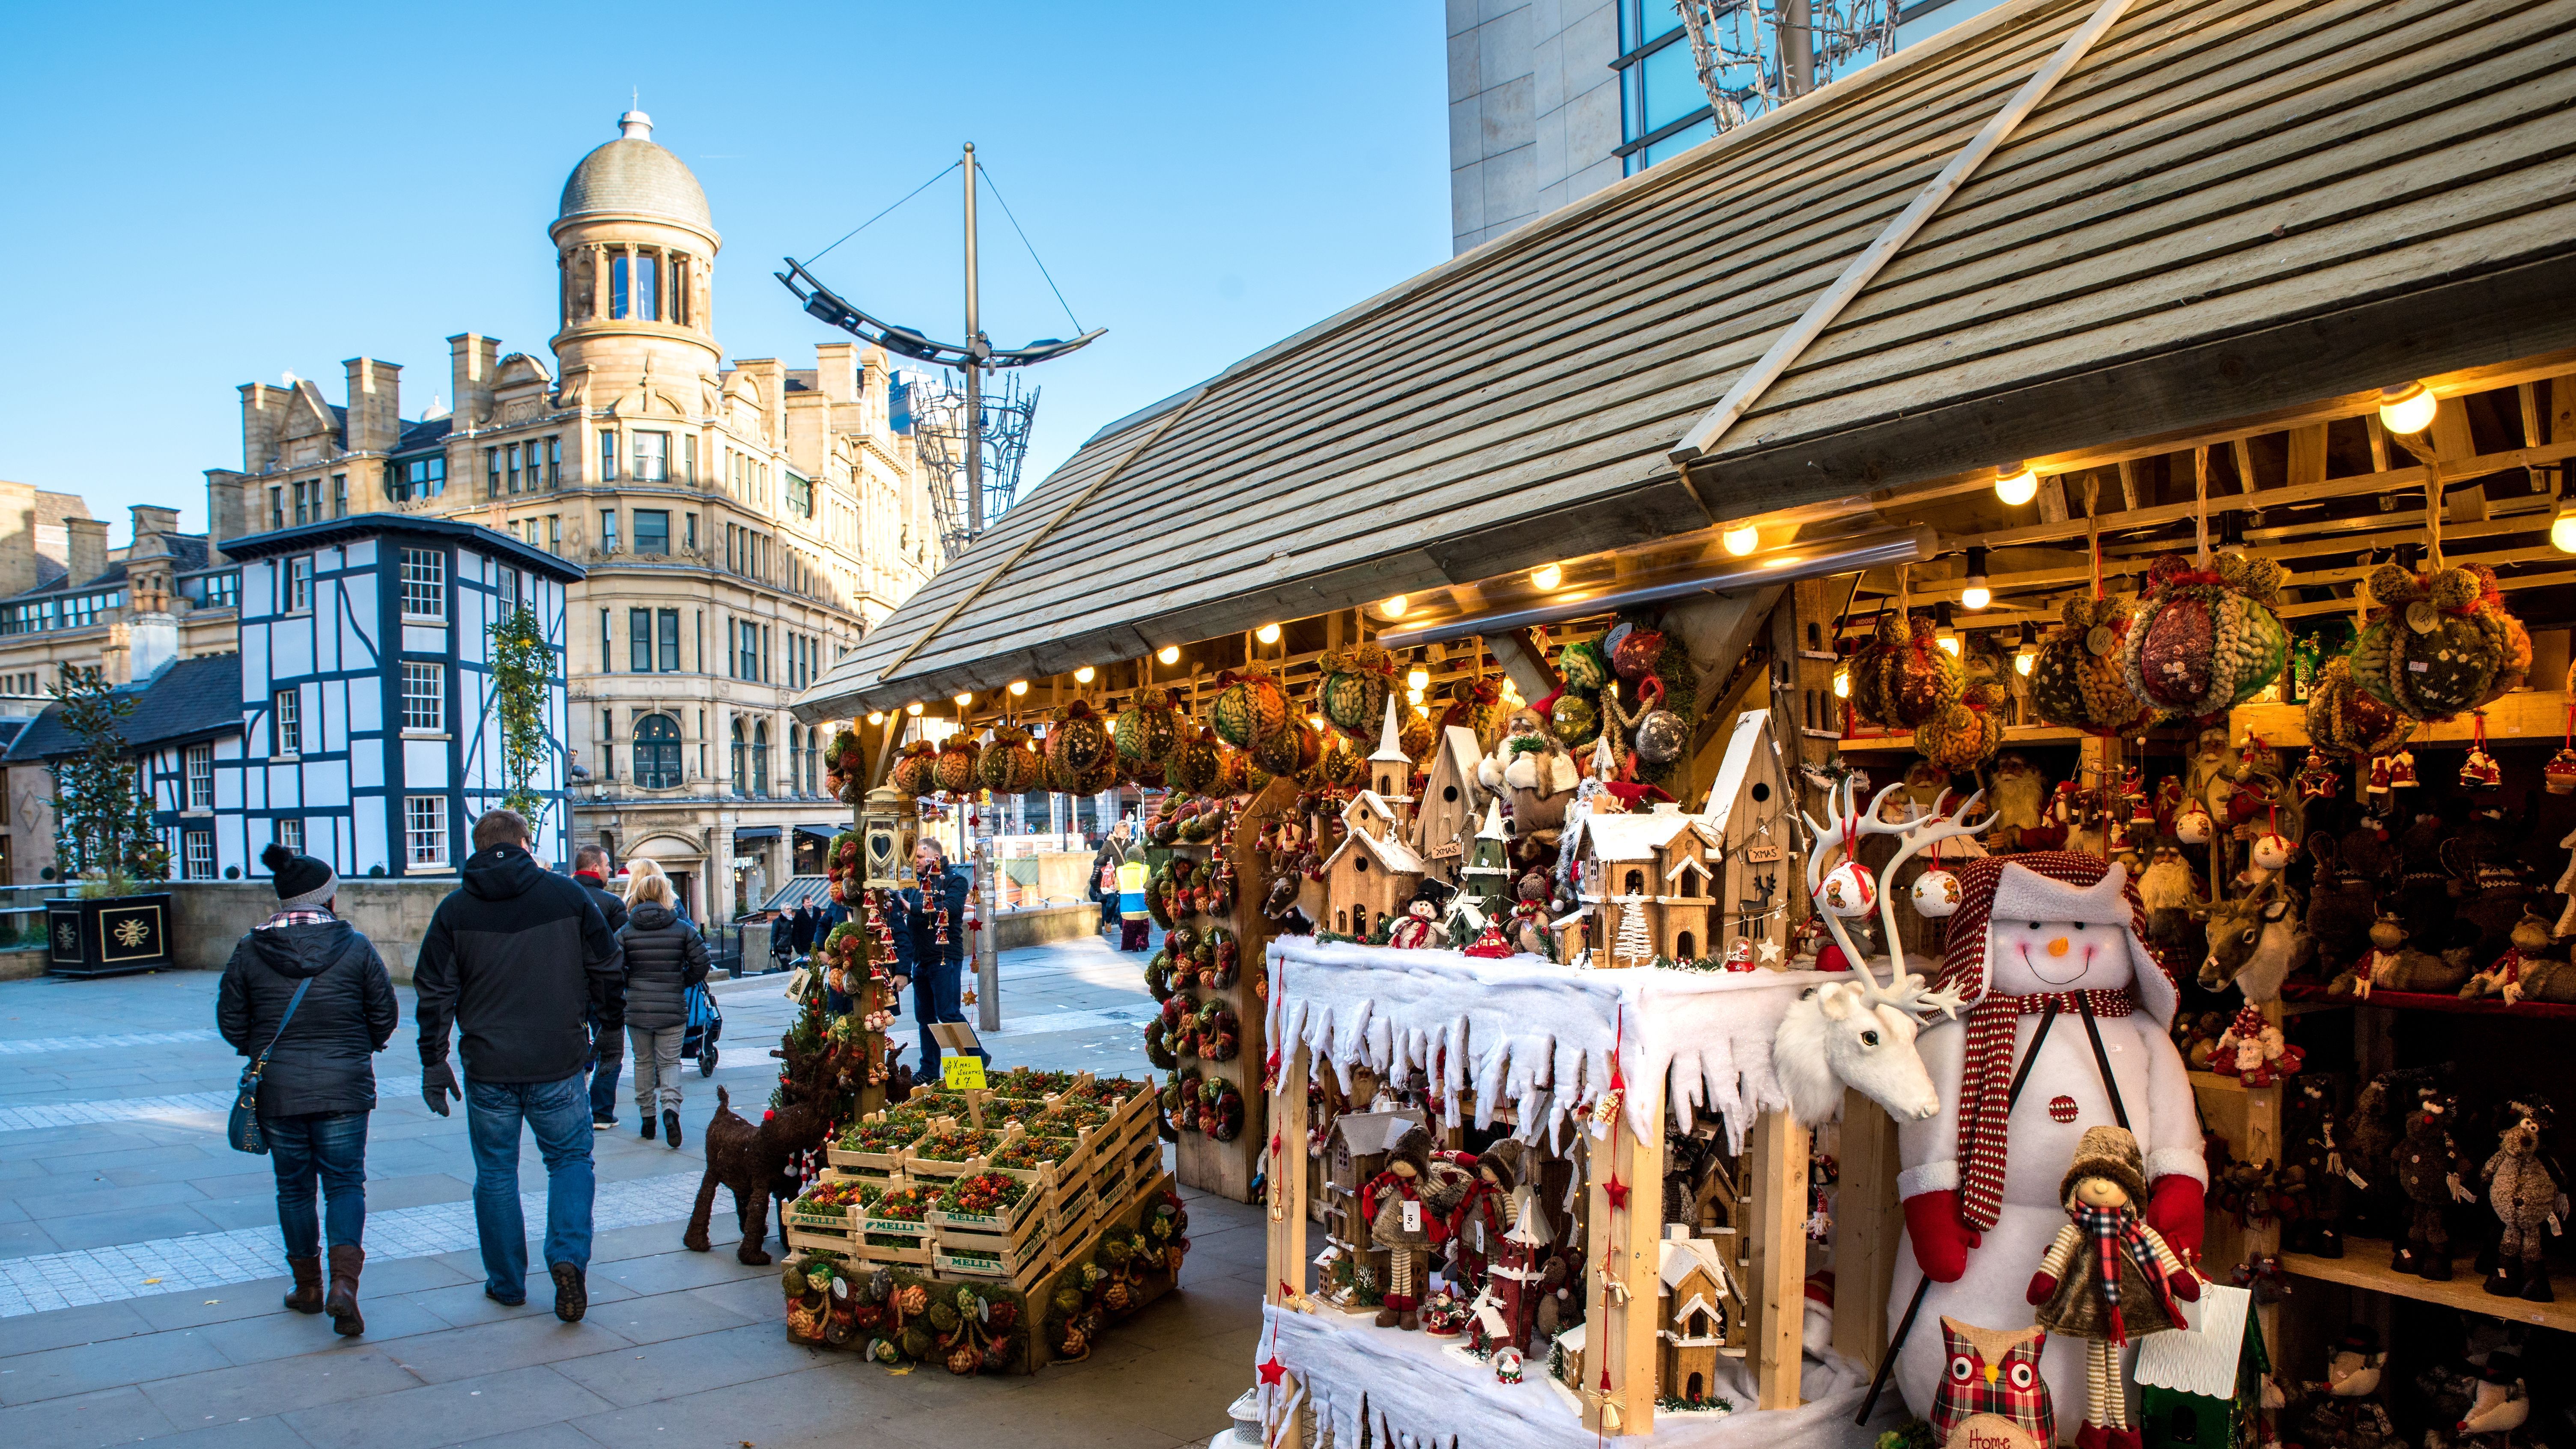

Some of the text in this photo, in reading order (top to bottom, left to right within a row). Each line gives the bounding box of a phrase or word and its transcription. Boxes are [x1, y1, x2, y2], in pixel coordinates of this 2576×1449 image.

[1436, 846, 1457, 856] XMAS
[1753, 849, 1777, 859] XMAS
[734, 856, 753, 870] anyan
[800, 1216, 837, 1225] MELLI
[947, 1213, 986, 1222] MELLI
[876, 1221, 915, 1231] MELLI
[951, 1258, 991, 1268] MELLI
[1969, 1428, 2011, 1449] Home
